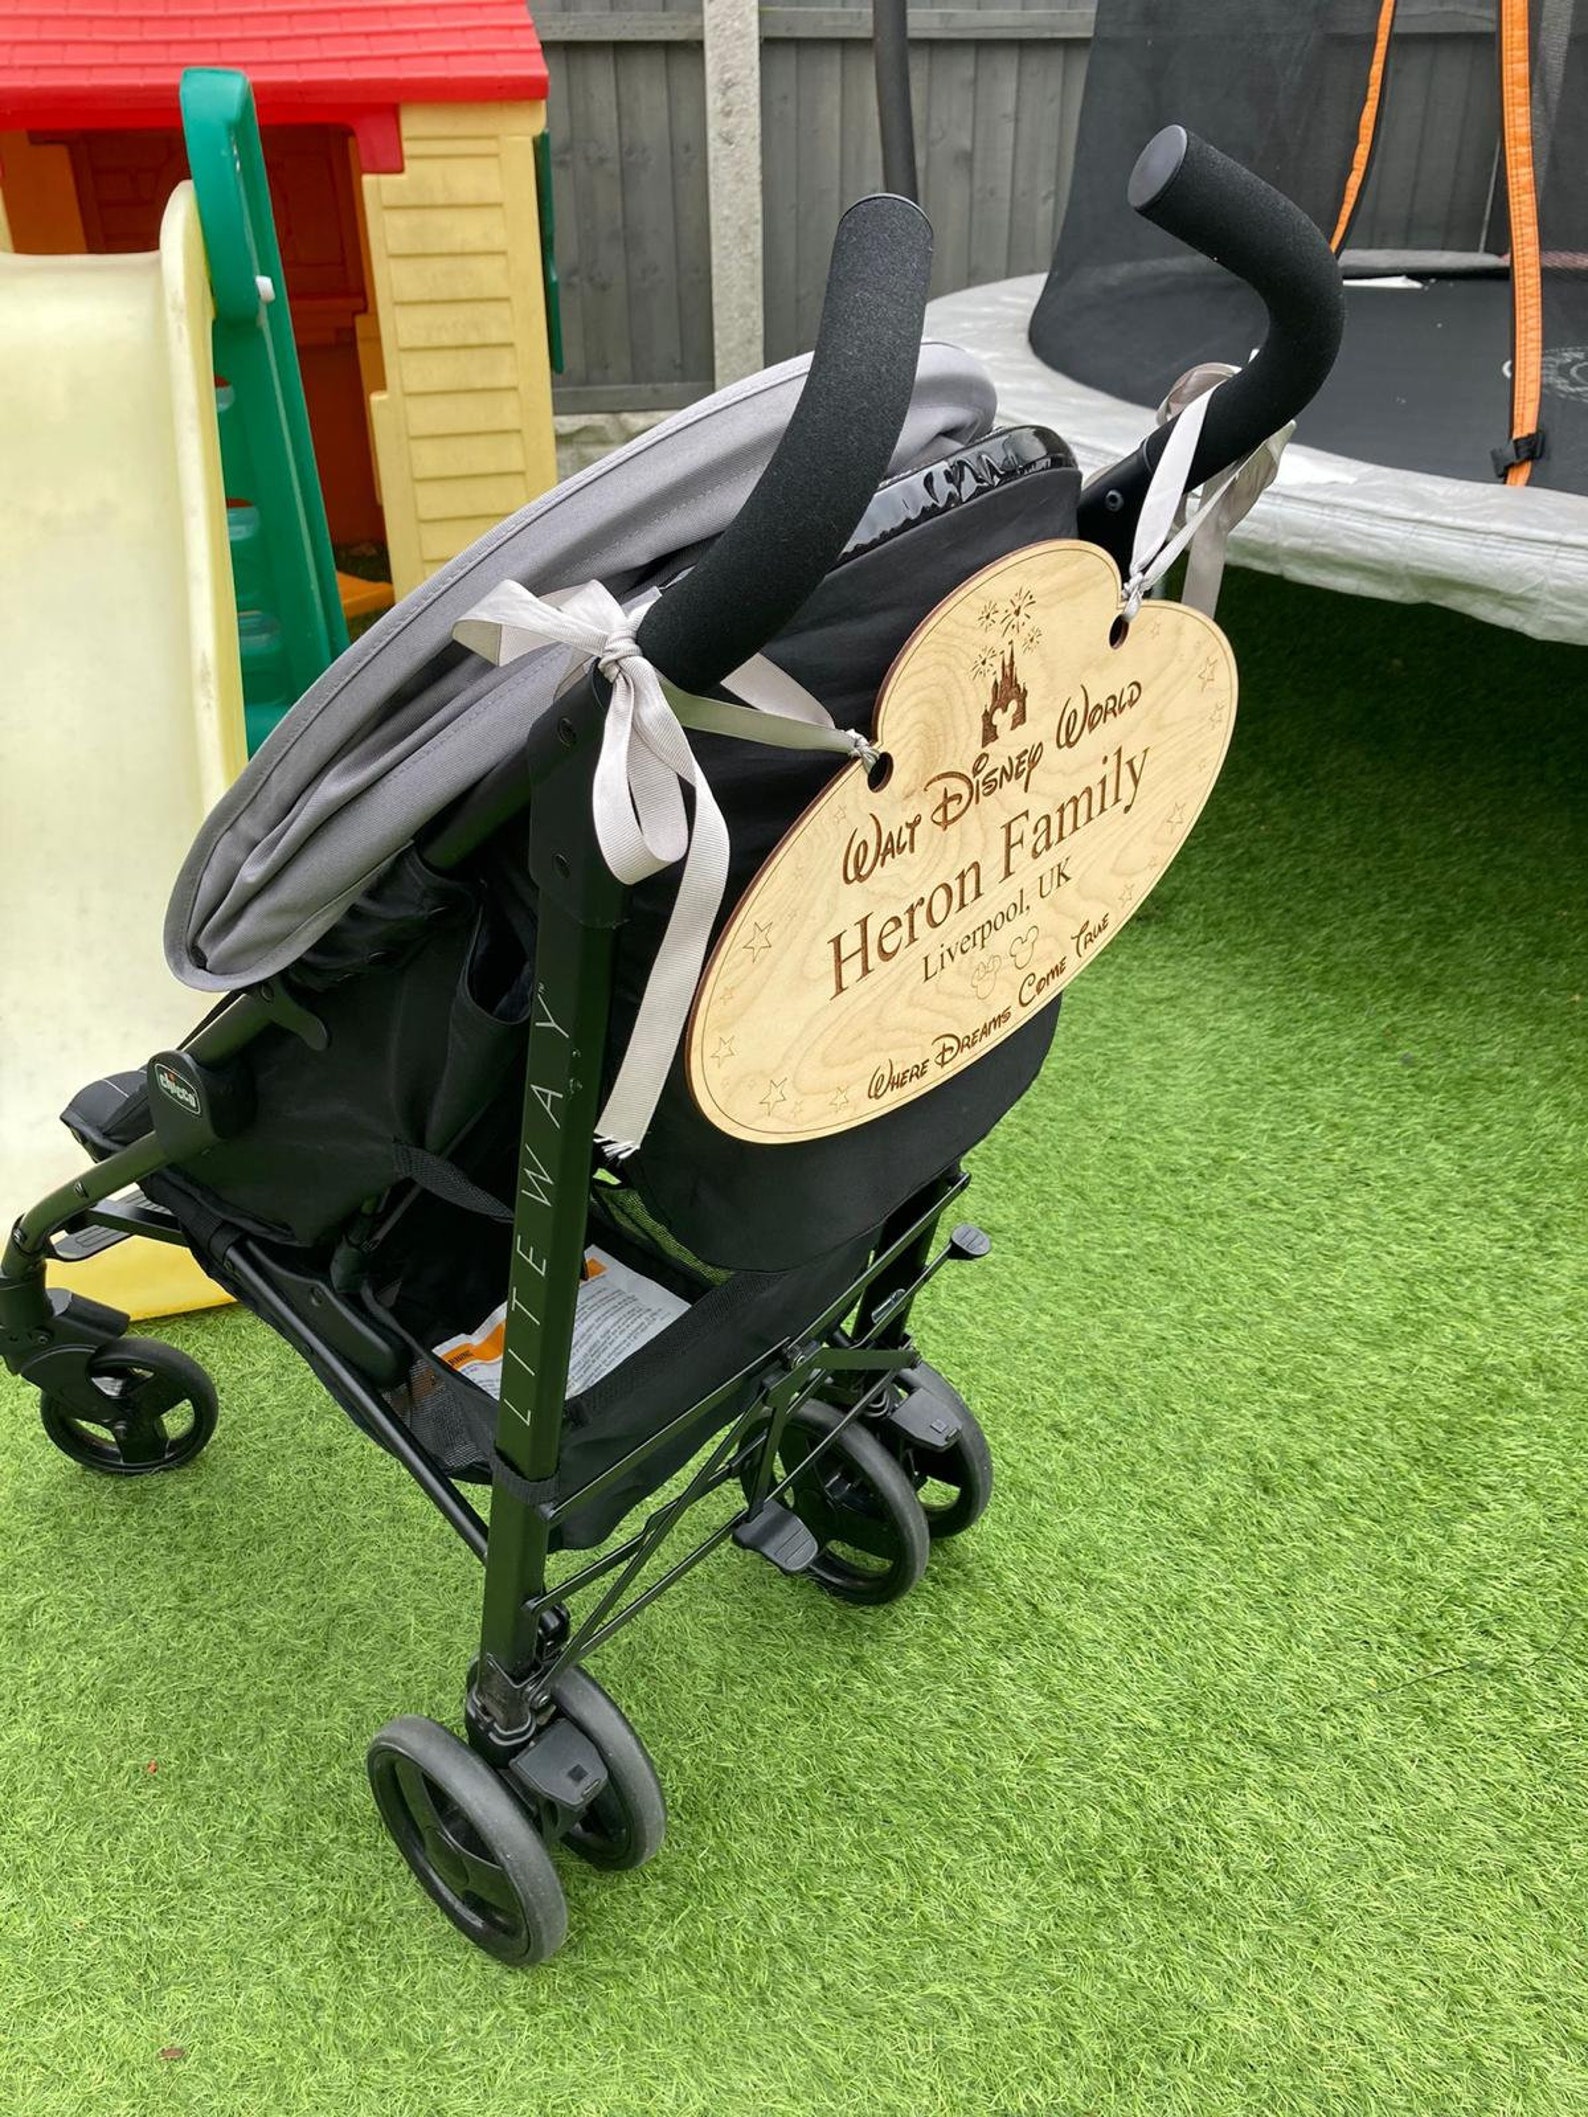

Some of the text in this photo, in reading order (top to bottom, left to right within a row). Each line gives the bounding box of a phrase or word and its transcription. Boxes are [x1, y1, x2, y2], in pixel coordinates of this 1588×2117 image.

[827, 744, 1150, 1001] Heron Family
[922, 855, 1072, 983] Liverpool, UK
